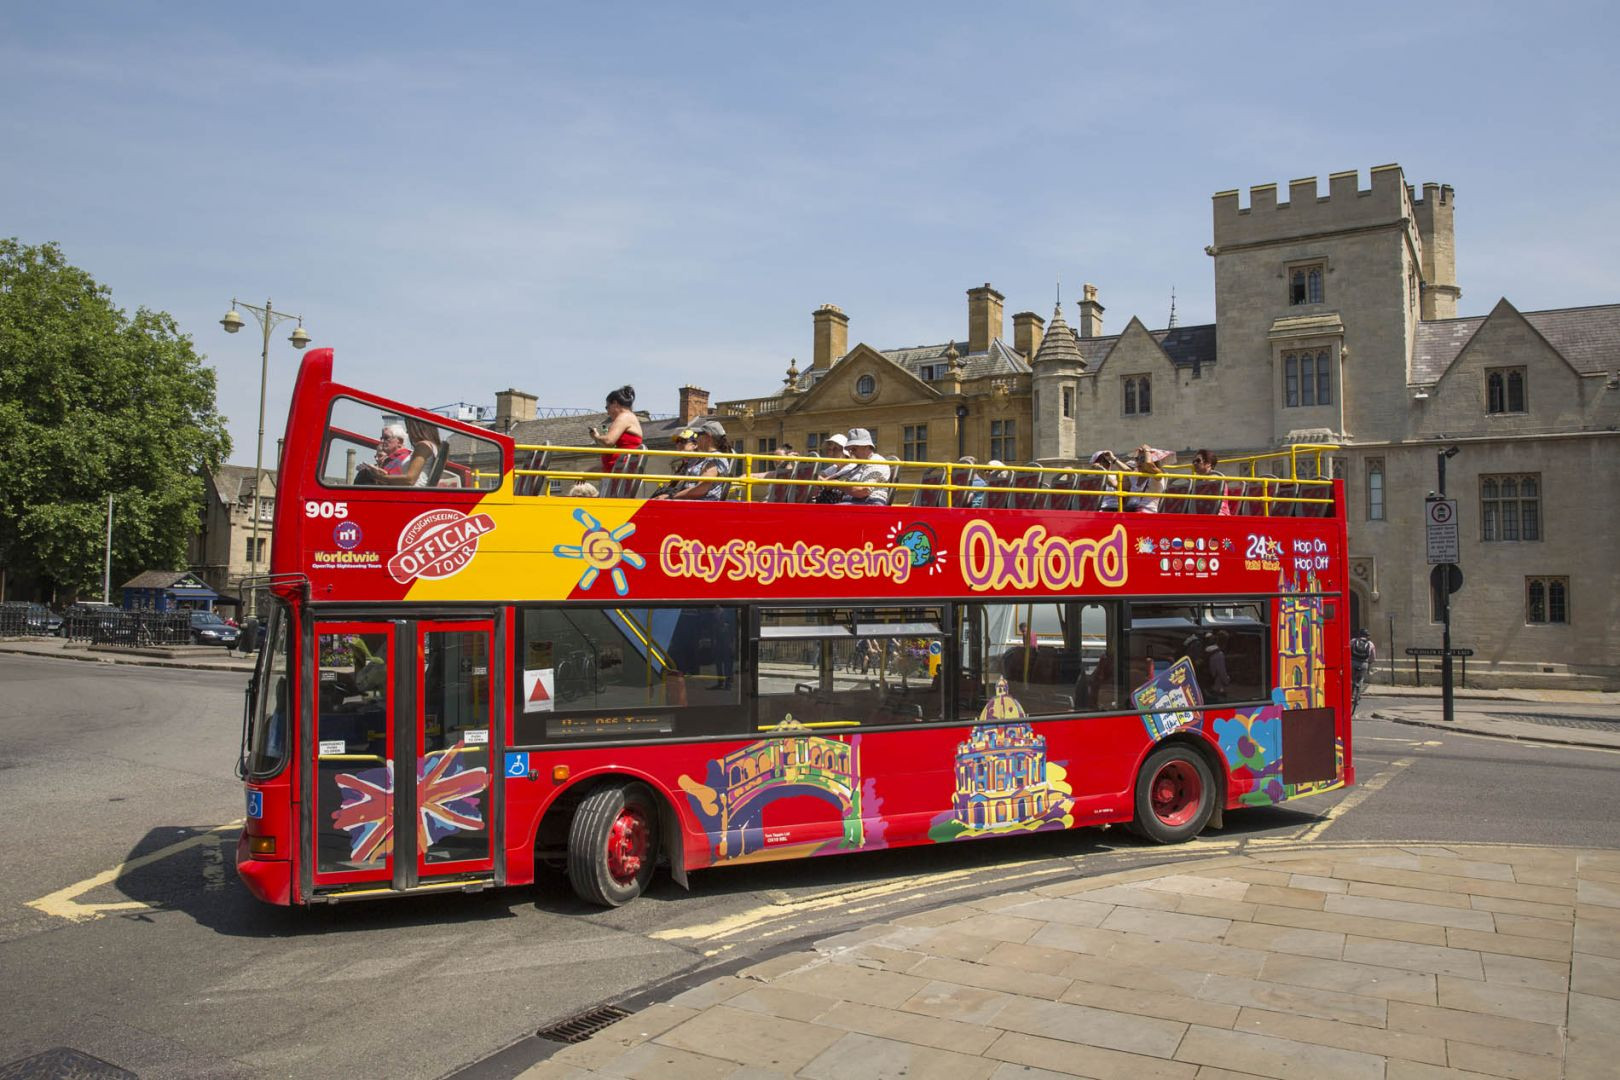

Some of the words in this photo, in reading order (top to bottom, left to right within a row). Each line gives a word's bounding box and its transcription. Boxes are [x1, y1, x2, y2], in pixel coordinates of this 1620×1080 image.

[305, 501, 349, 518] 905
[405, 512, 459, 545] CITYSIGHTSEEING
[314, 550, 380, 563] Worldwide
[399, 517, 491, 574] OFFICIAL
[660, 533, 912, 585] CitySightseeing
[959, 518, 1129, 592] Oxford
[1246, 534, 1266, 559] 24
[1293, 538, 1312, 554] Hop
[1314, 538, 1327, 552] On
[434, 545, 474, 574] TOUR
[1294, 557, 1313, 570] Hop
[1315, 556, 1329, 569] Off
